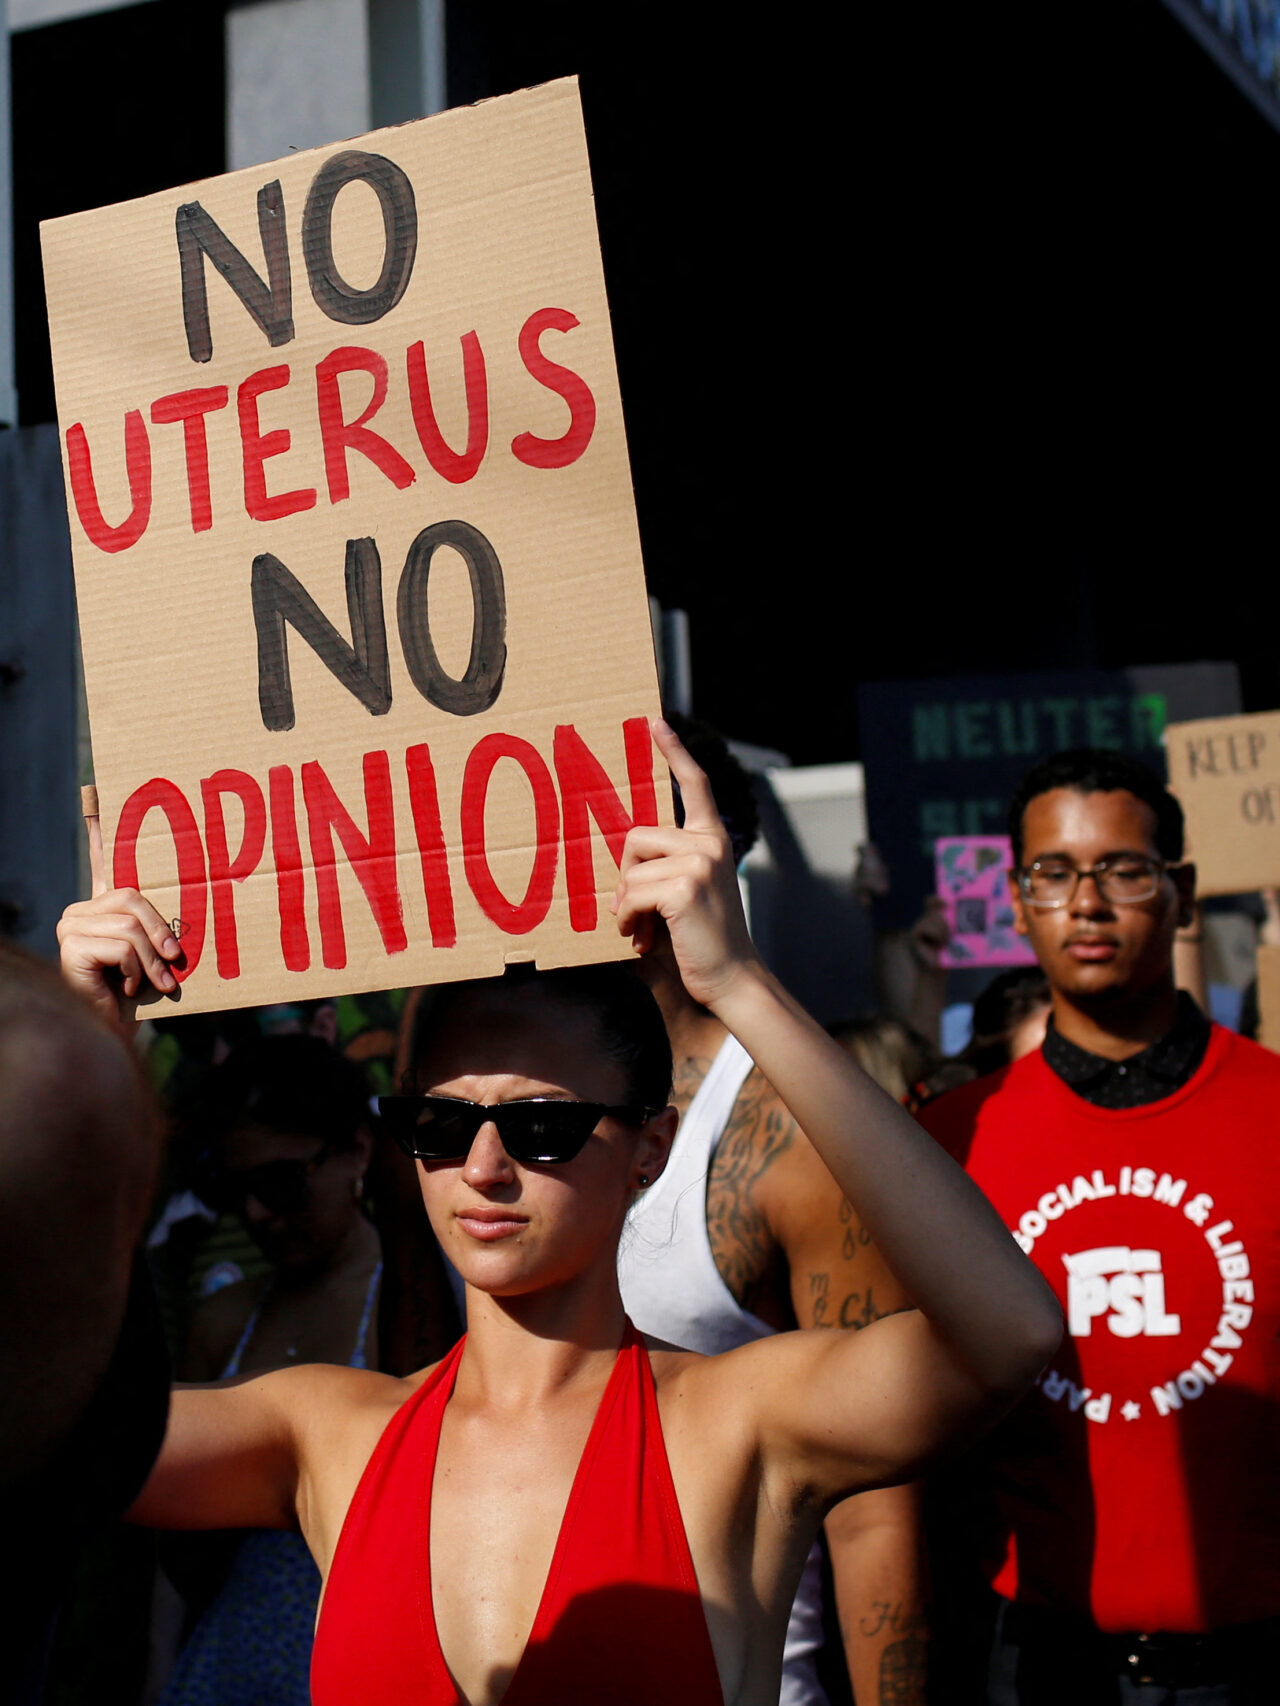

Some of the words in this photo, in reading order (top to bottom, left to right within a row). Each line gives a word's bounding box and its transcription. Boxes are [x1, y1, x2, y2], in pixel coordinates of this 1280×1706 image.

[175, 149, 419, 364] NO
[65, 307, 597, 554] UTERUS
[250, 519, 507, 732] NO
[910, 692, 1167, 762] NEUTER
[112, 716, 660, 985] OPINION
[1011, 1166, 1188, 1255] SOCIALISM
[1183, 1193, 1214, 1227] &
[1067, 1270, 1181, 1338] PSL
[1150, 1219, 1255, 1416] LIBERATION
[1038, 1369, 1113, 1424] PAR
